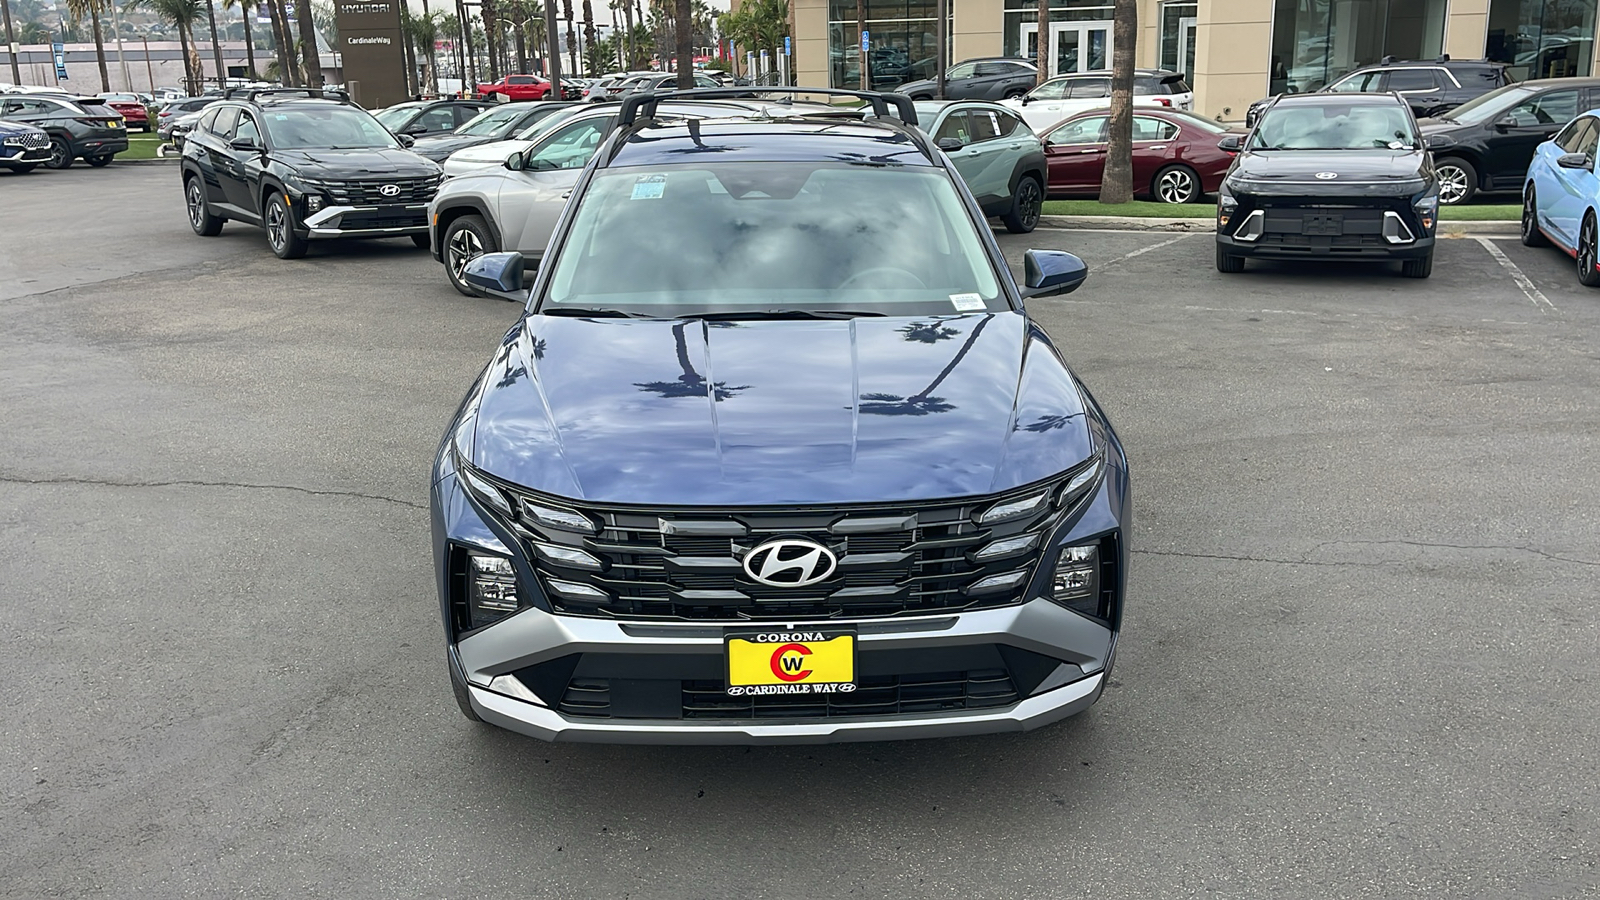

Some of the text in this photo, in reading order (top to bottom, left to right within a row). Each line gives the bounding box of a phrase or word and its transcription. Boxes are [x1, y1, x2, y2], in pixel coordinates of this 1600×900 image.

[341, 4, 390, 14] HYUNDAI
[347, 36, 391, 45] CardinaleWay
[756, 632, 825, 643] CORONA
[745, 683, 838, 695] CARDINALE WAY
